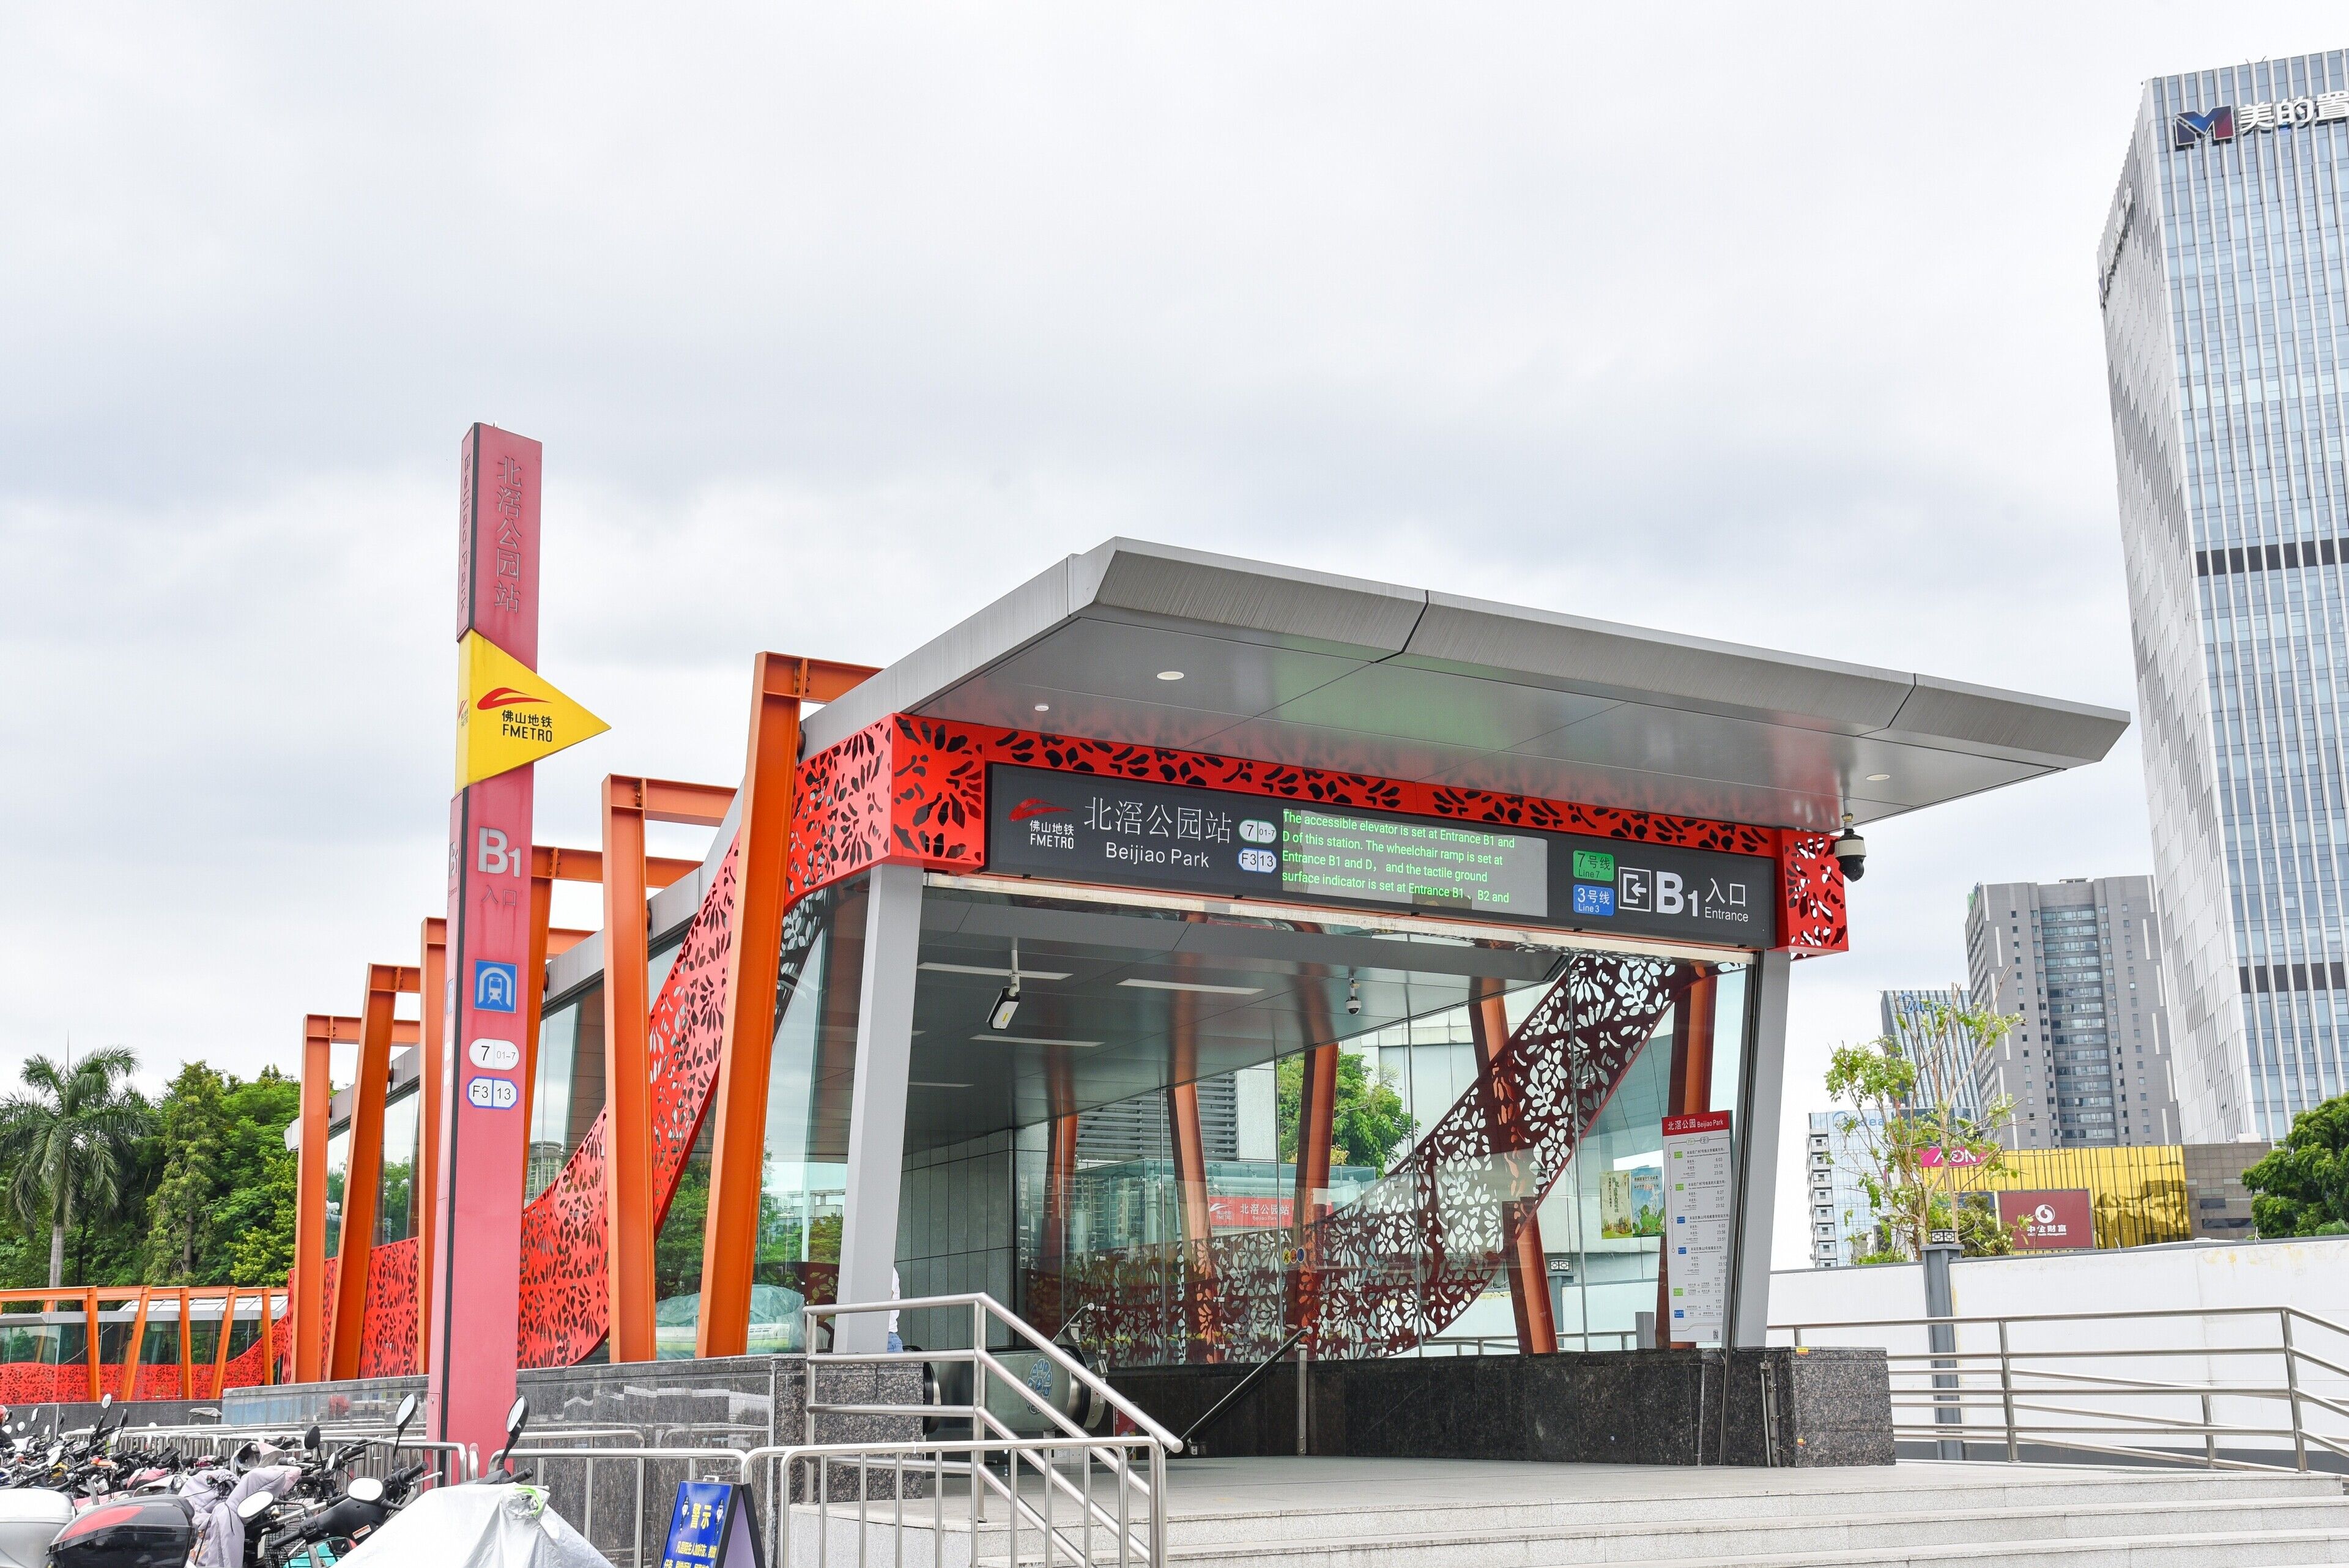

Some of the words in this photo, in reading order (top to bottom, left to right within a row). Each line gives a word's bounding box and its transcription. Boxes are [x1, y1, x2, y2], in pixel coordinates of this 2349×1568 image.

[2238, 90, 2349, 132] 美的置
[494, 455, 522, 614] 北滘公园站
[502, 709, 552, 728] 佛山地铁
[502, 724, 553, 743] FMETRO
[1030, 819, 1074, 836] 佛山地铁
[1083, 797, 1232, 844] 北滘公园站
[1246, 824, 1254, 837] 7
[1259, 828, 1275, 837] 01-7
[1283, 811, 1302, 823] The
[1304, 816, 1357, 830] accessible
[1360, 821, 1398, 835] elevator
[1400, 825, 1409, 836] is
[1411, 828, 1426, 838] set
[1428, 830, 1438, 839] at
[1440, 830, 1480, 844] Entrance
[1483, 835, 1494, 845] B1
[1498, 838, 1515, 849] and
[1030, 833, 1074, 850] FMETRO
[1283, 830, 1290, 842] D
[1293, 832, 1303, 843] of
[1305, 833, 1324, 845] this
[1327, 838, 1363, 850] station.
[1365, 839, 1384, 852] The
[1386, 843, 1438, 858] wheelchair
[1441, 850, 1464, 863] ramp
[1467, 852, 1475, 862] is
[1477, 854, 1492, 864] set
[1494, 855, 1503, 865] at
[478, 826, 521, 878] B1
[1106, 842, 1165, 865] Beijiao
[1171, 848, 1209, 868] Park
[1241, 853, 1256, 866] F3
[1260, 855, 1274, 867] 13
[1283, 850, 1326, 865] Entrance
[1329, 855, 1340, 867] B1
[1344, 858, 1362, 869] and
[1386, 863, 1403, 874] and
[1406, 864, 1421, 875] the
[1423, 866, 1452, 878] tactile
[1455, 872, 1488, 882] ground
[1577, 853, 1611, 871] 7号线
[1578, 869, 1595, 878] Line
[481, 885, 517, 907] 入口
[1282, 871, 1319, 884] surface
[1323, 874, 1365, 889] indicator
[1368, 879, 1376, 889] is
[1379, 882, 1394, 892] set
[1397, 883, 1406, 893] at
[1409, 883, 1450, 897] Entrance
[1477, 890, 1490, 901] B2
[1492, 893, 1509, 903] and
[1656, 871, 1698, 916] B1
[1705, 877, 1746, 907] 入口
[1577, 888, 1610, 905] 3号线
[1578, 904, 1595, 913] Line
[1705, 907, 1749, 923] Entrance
[481, 1045, 490, 1061] 7
[496, 1050, 516, 1060] 01-7
[472, 1085, 489, 1099] F3
[497, 1088, 511, 1100] 13
[1668, 1118, 1696, 1131] 北滘公园
[1240, 1203, 1289, 1216] 北滘公园站
[2027, 1224, 2066, 1233] 中金财富
